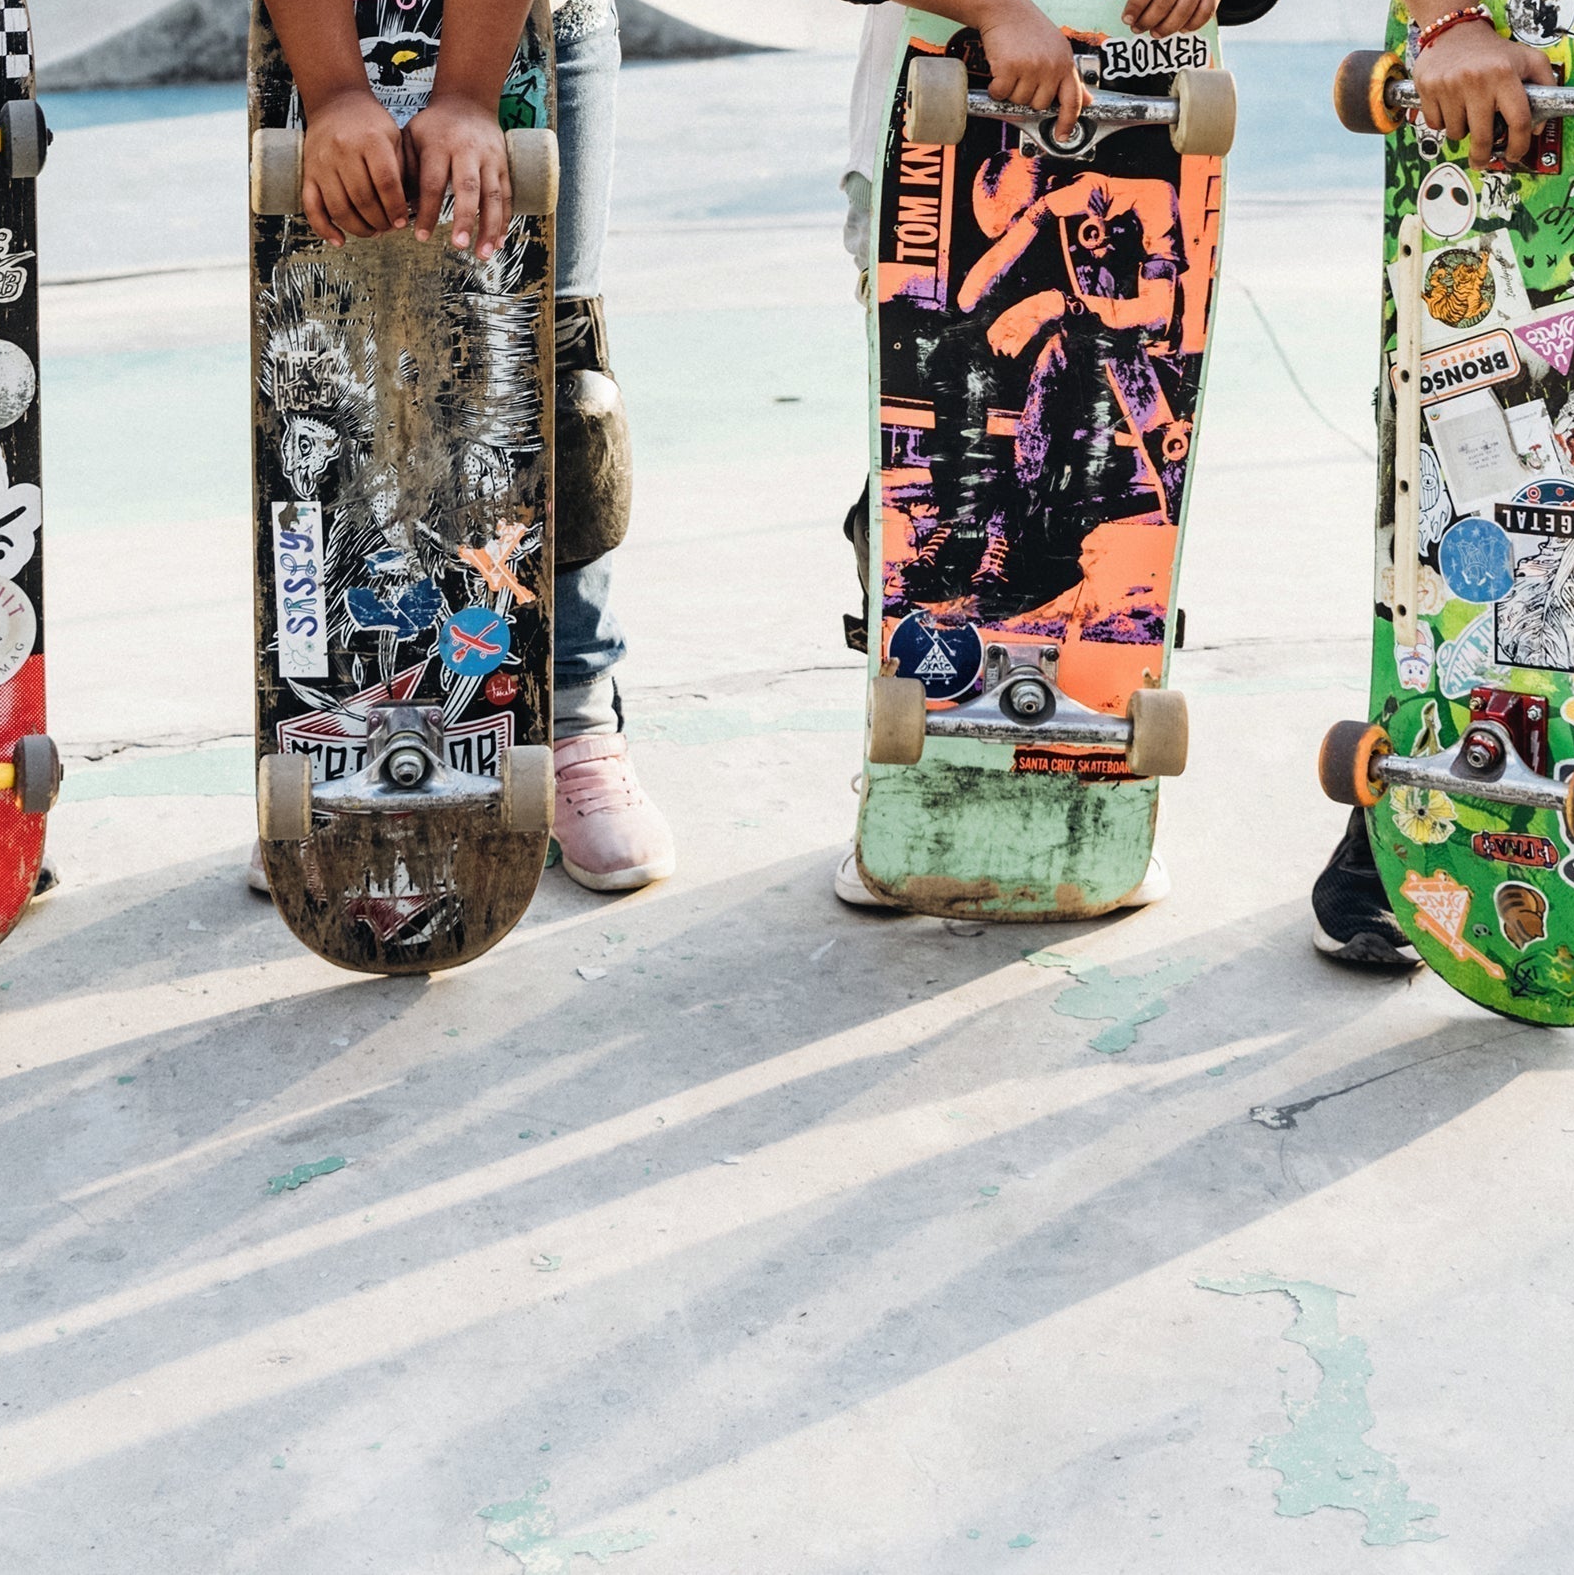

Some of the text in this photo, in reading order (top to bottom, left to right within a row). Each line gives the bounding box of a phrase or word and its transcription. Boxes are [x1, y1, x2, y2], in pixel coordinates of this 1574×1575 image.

[1107, 35, 1207, 77] BONES
[896, 193, 940, 262] TOM
[1421, 350, 1510, 394] BRONSO
[1018, 756, 1049, 771] SANTA
[1051, 758, 1076, 772] CRUZ
